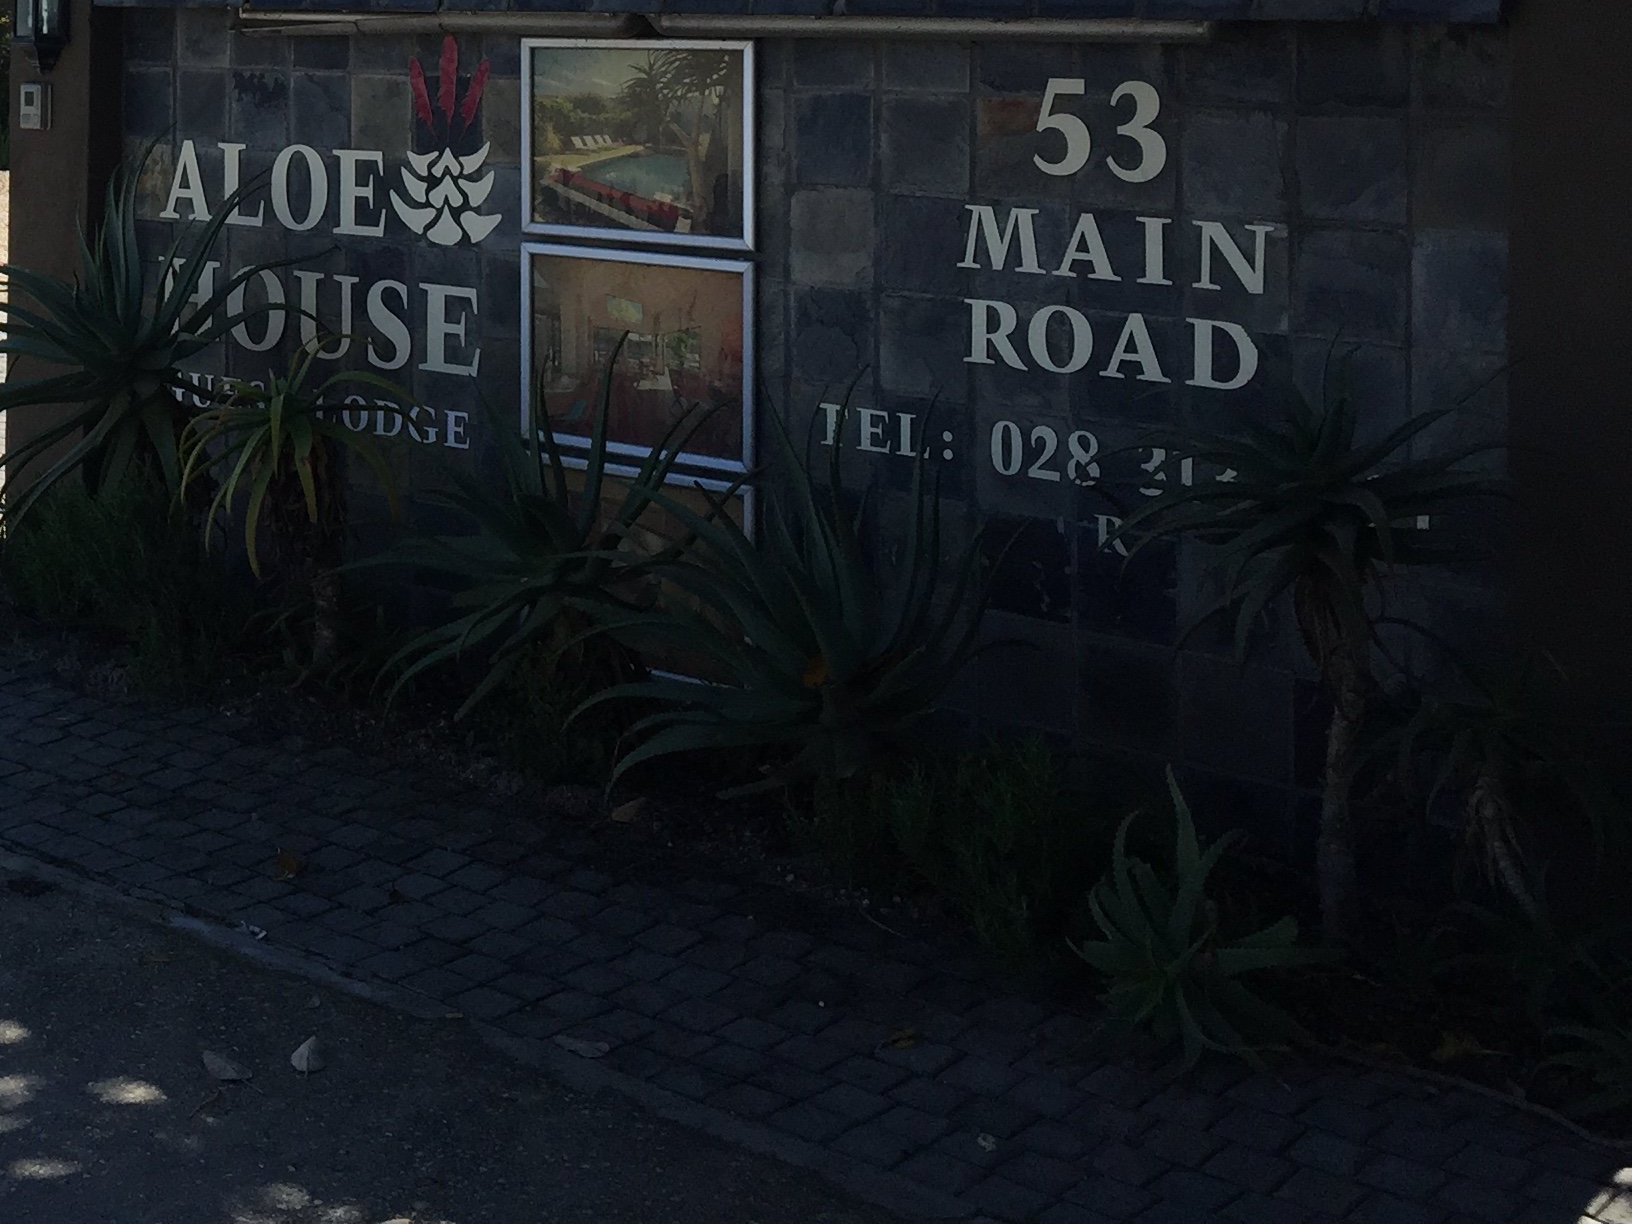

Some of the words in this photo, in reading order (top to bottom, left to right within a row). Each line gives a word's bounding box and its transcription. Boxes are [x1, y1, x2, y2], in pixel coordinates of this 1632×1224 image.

[1032, 77, 1168, 183] 53
[159, 139, 388, 238] ALOE
[956, 204, 1275, 295] MAIN
[962, 298, 1259, 390] ROAD
[819, 402, 954, 461] TEL:
[990, 420, 1102, 487] 028
